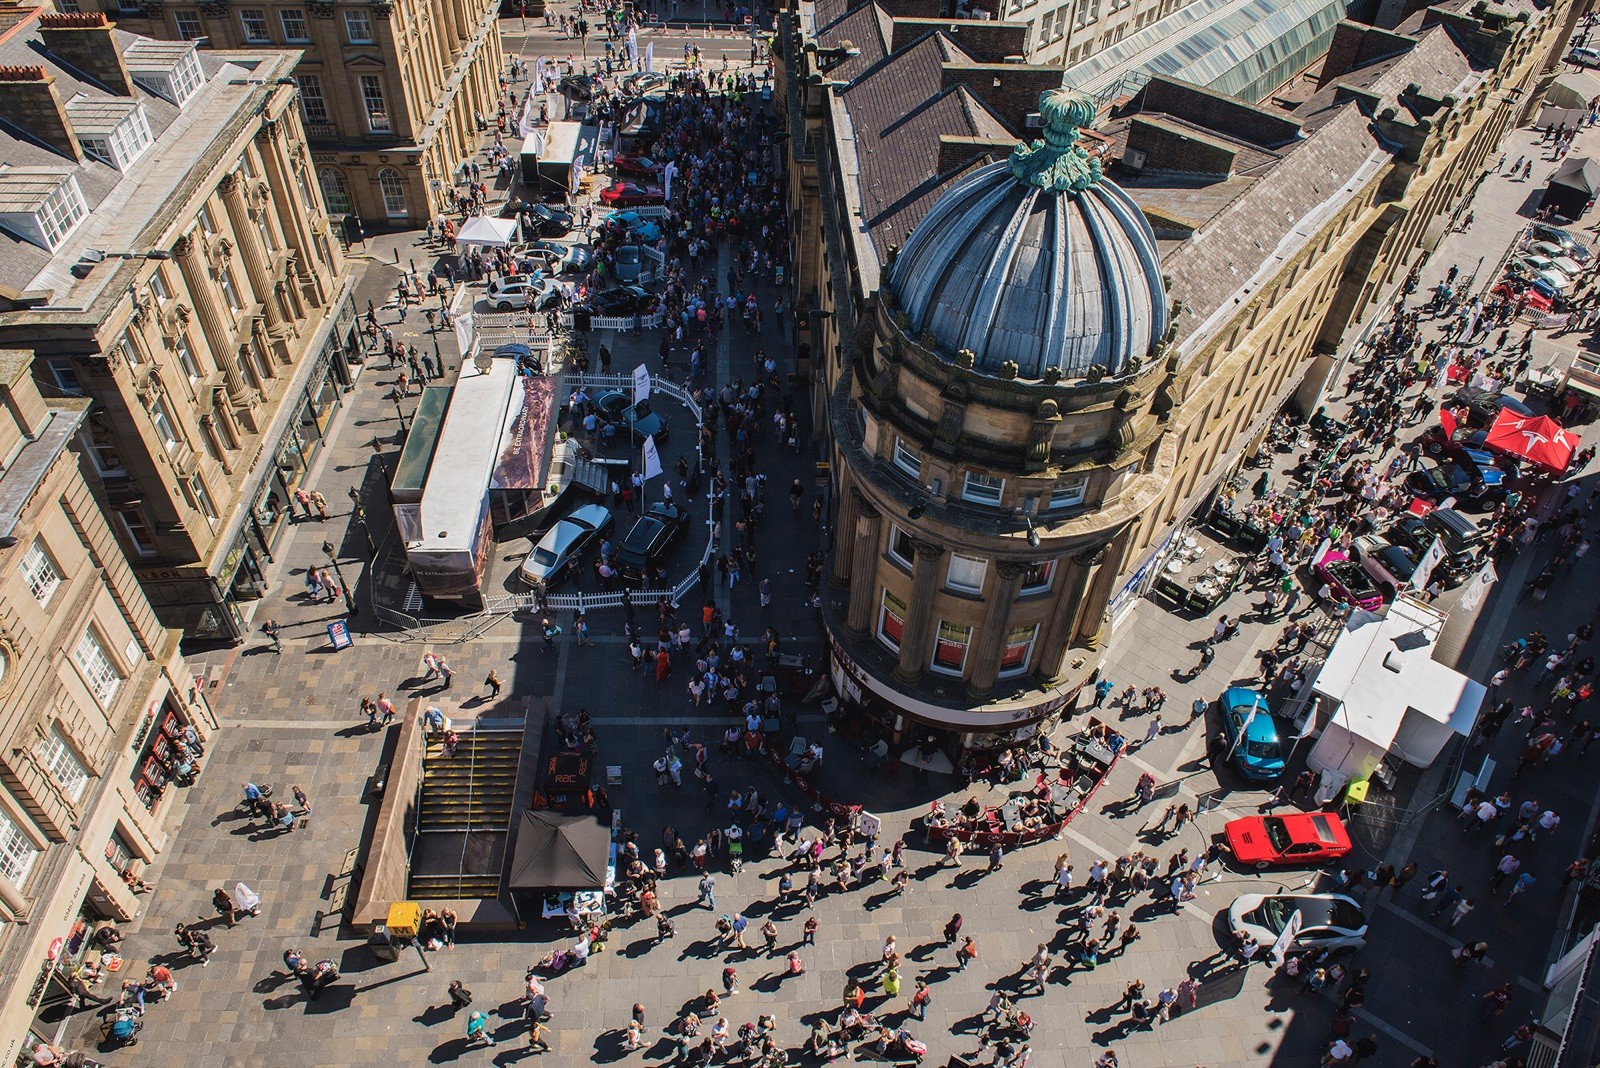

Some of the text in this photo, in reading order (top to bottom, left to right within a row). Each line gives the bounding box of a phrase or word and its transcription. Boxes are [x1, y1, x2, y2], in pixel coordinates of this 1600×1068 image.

[313, 155, 337, 163] BANK
[514, 405, 529, 447] EXTRAORDINARY
[64, 900, 75, 921] 03457
[73, 888, 81, 899] 404
